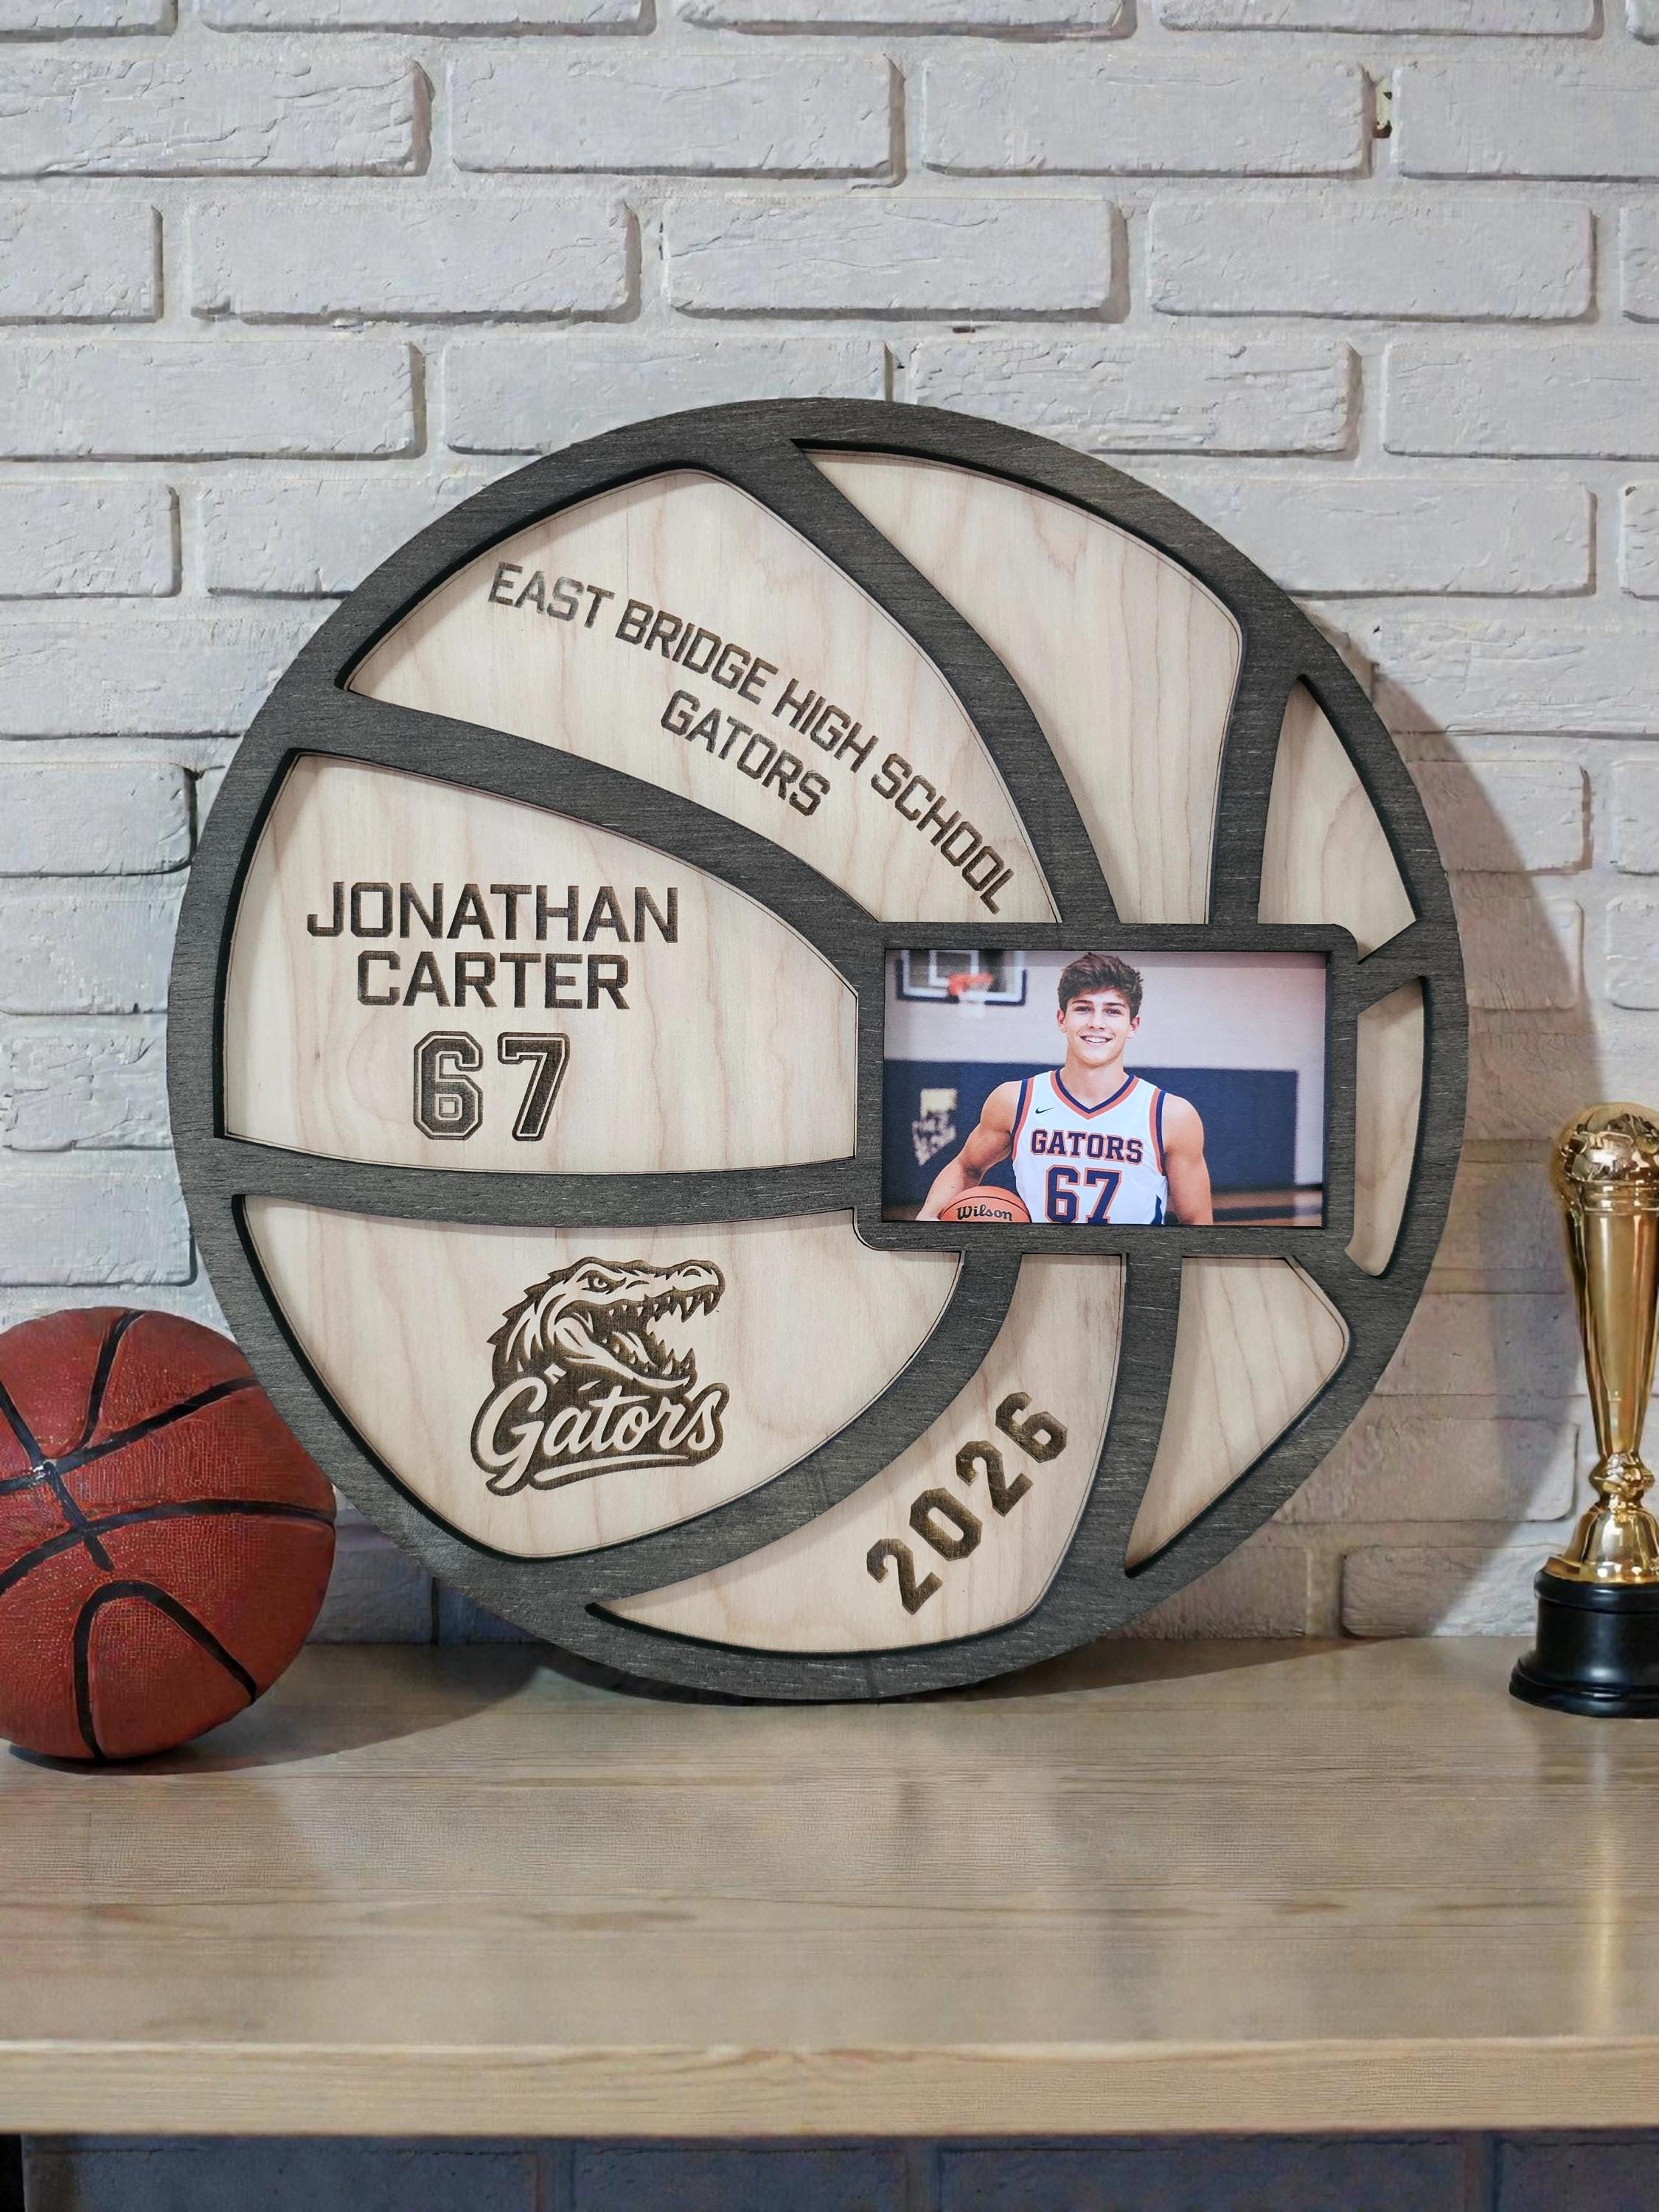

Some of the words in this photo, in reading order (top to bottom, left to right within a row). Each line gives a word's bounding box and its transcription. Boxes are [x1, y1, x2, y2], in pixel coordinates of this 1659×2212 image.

[487, 562, 614, 629] EAST
[615, 598, 779, 705] BRIDGE
[772, 678, 879, 774] HIGH
[871, 753, 1015, 915] SCHOOL
[660, 689, 831, 818] GATORS
[307, 881, 678, 943] JONATHAN
[357, 950, 630, 1009] CARTER
[413, 1030, 571, 1142] 67
[1032, 1129, 1143, 1164] GATORS
[956, 1204, 1012, 1221] Wilson
[1046, 1166, 1122, 1223] 67
[473, 1375, 726, 1490] Gators
[866, 1391, 1068, 1615] 2026
